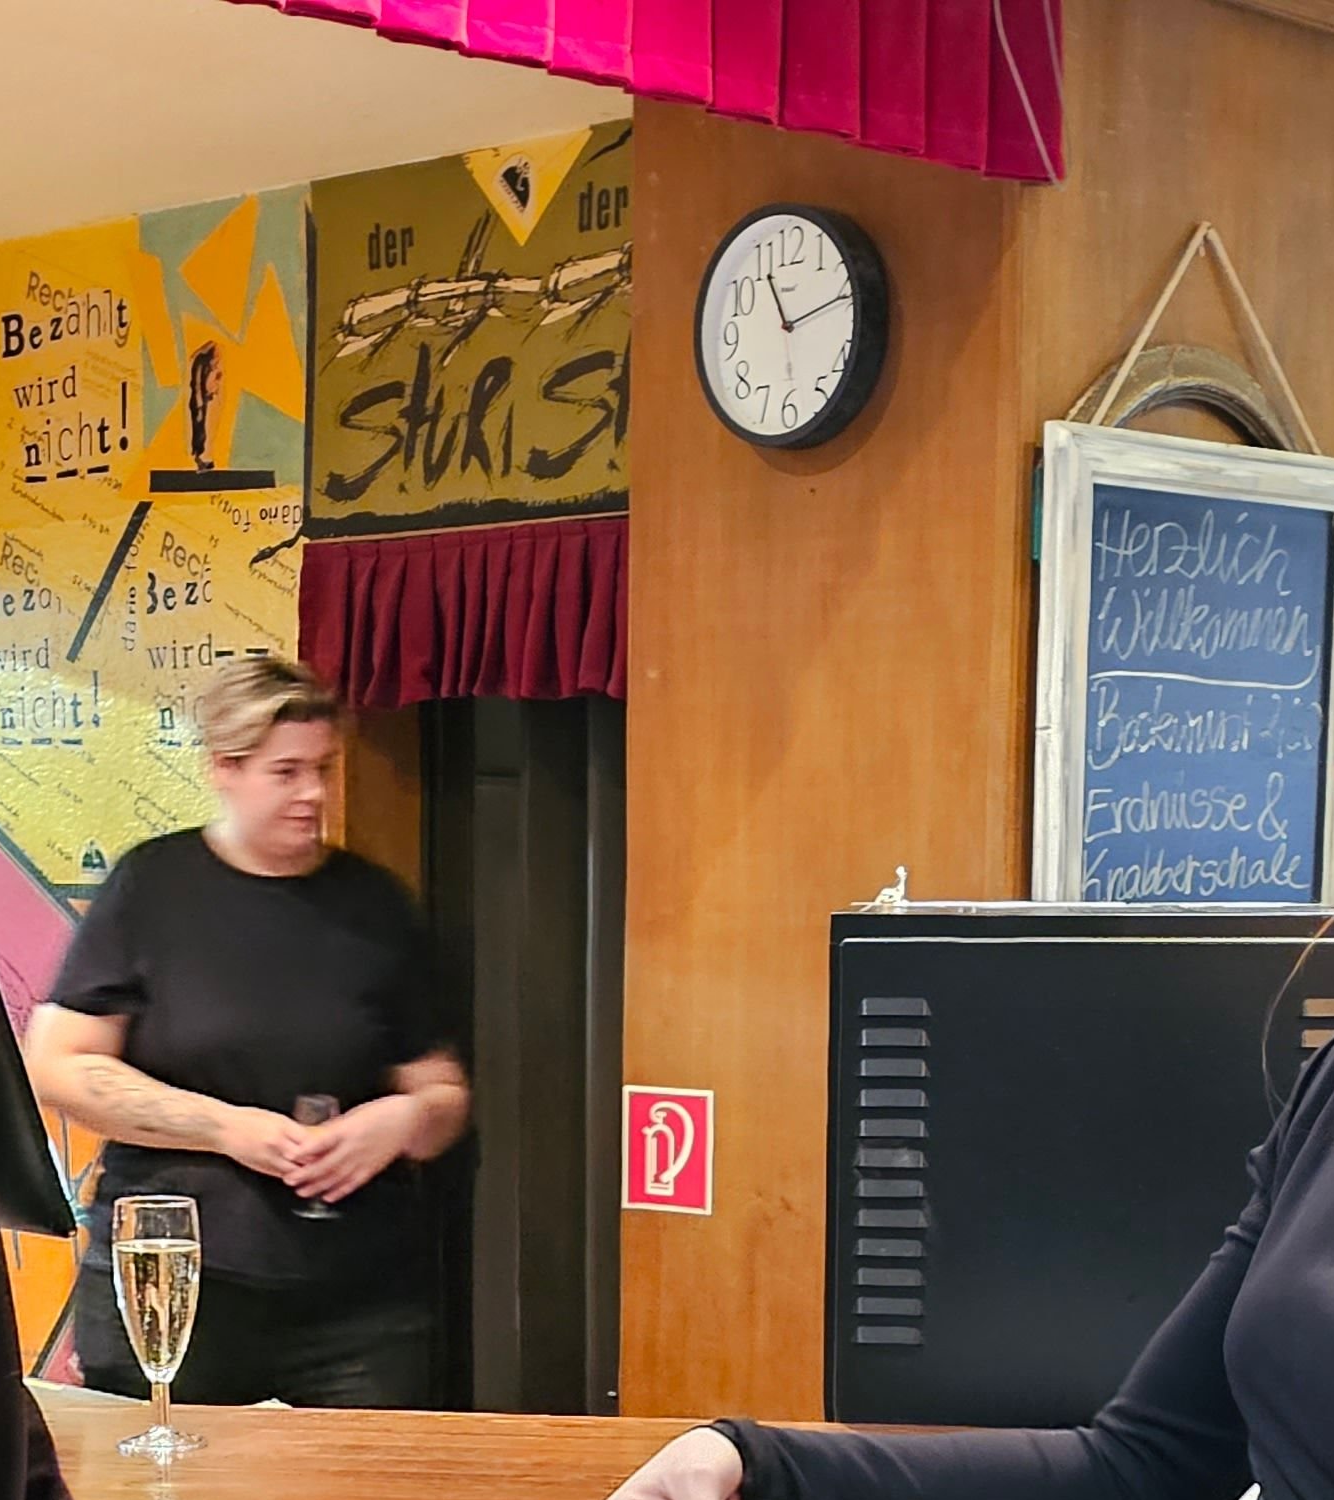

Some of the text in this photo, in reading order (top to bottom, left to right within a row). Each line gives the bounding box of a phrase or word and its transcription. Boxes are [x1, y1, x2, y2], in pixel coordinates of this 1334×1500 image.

[368, 223, 415, 270] der
[754, 241, 775, 282] 11
[778, 225, 806, 268] 12
[816, 232, 825, 272] 1
[726, 275, 755, 318] 10
[1, 289, 129, 359] Bezahlt
[723, 320, 740, 361] 9
[13, 365, 78, 409] wird
[735, 359, 752, 400] 8
[24, 381, 131, 458] nicht!
[754, 384, 771, 424] 7
[781, 388, 799, 429] 6
[1094, 509, 1292, 596] Herzlich
[1097, 584, 1313, 660] Willkommen
[147, 633, 213, 670] wird
[1084, 771, 1288, 843] Erdnüsse &
[1083, 842, 1311, 902] Knabberschale
